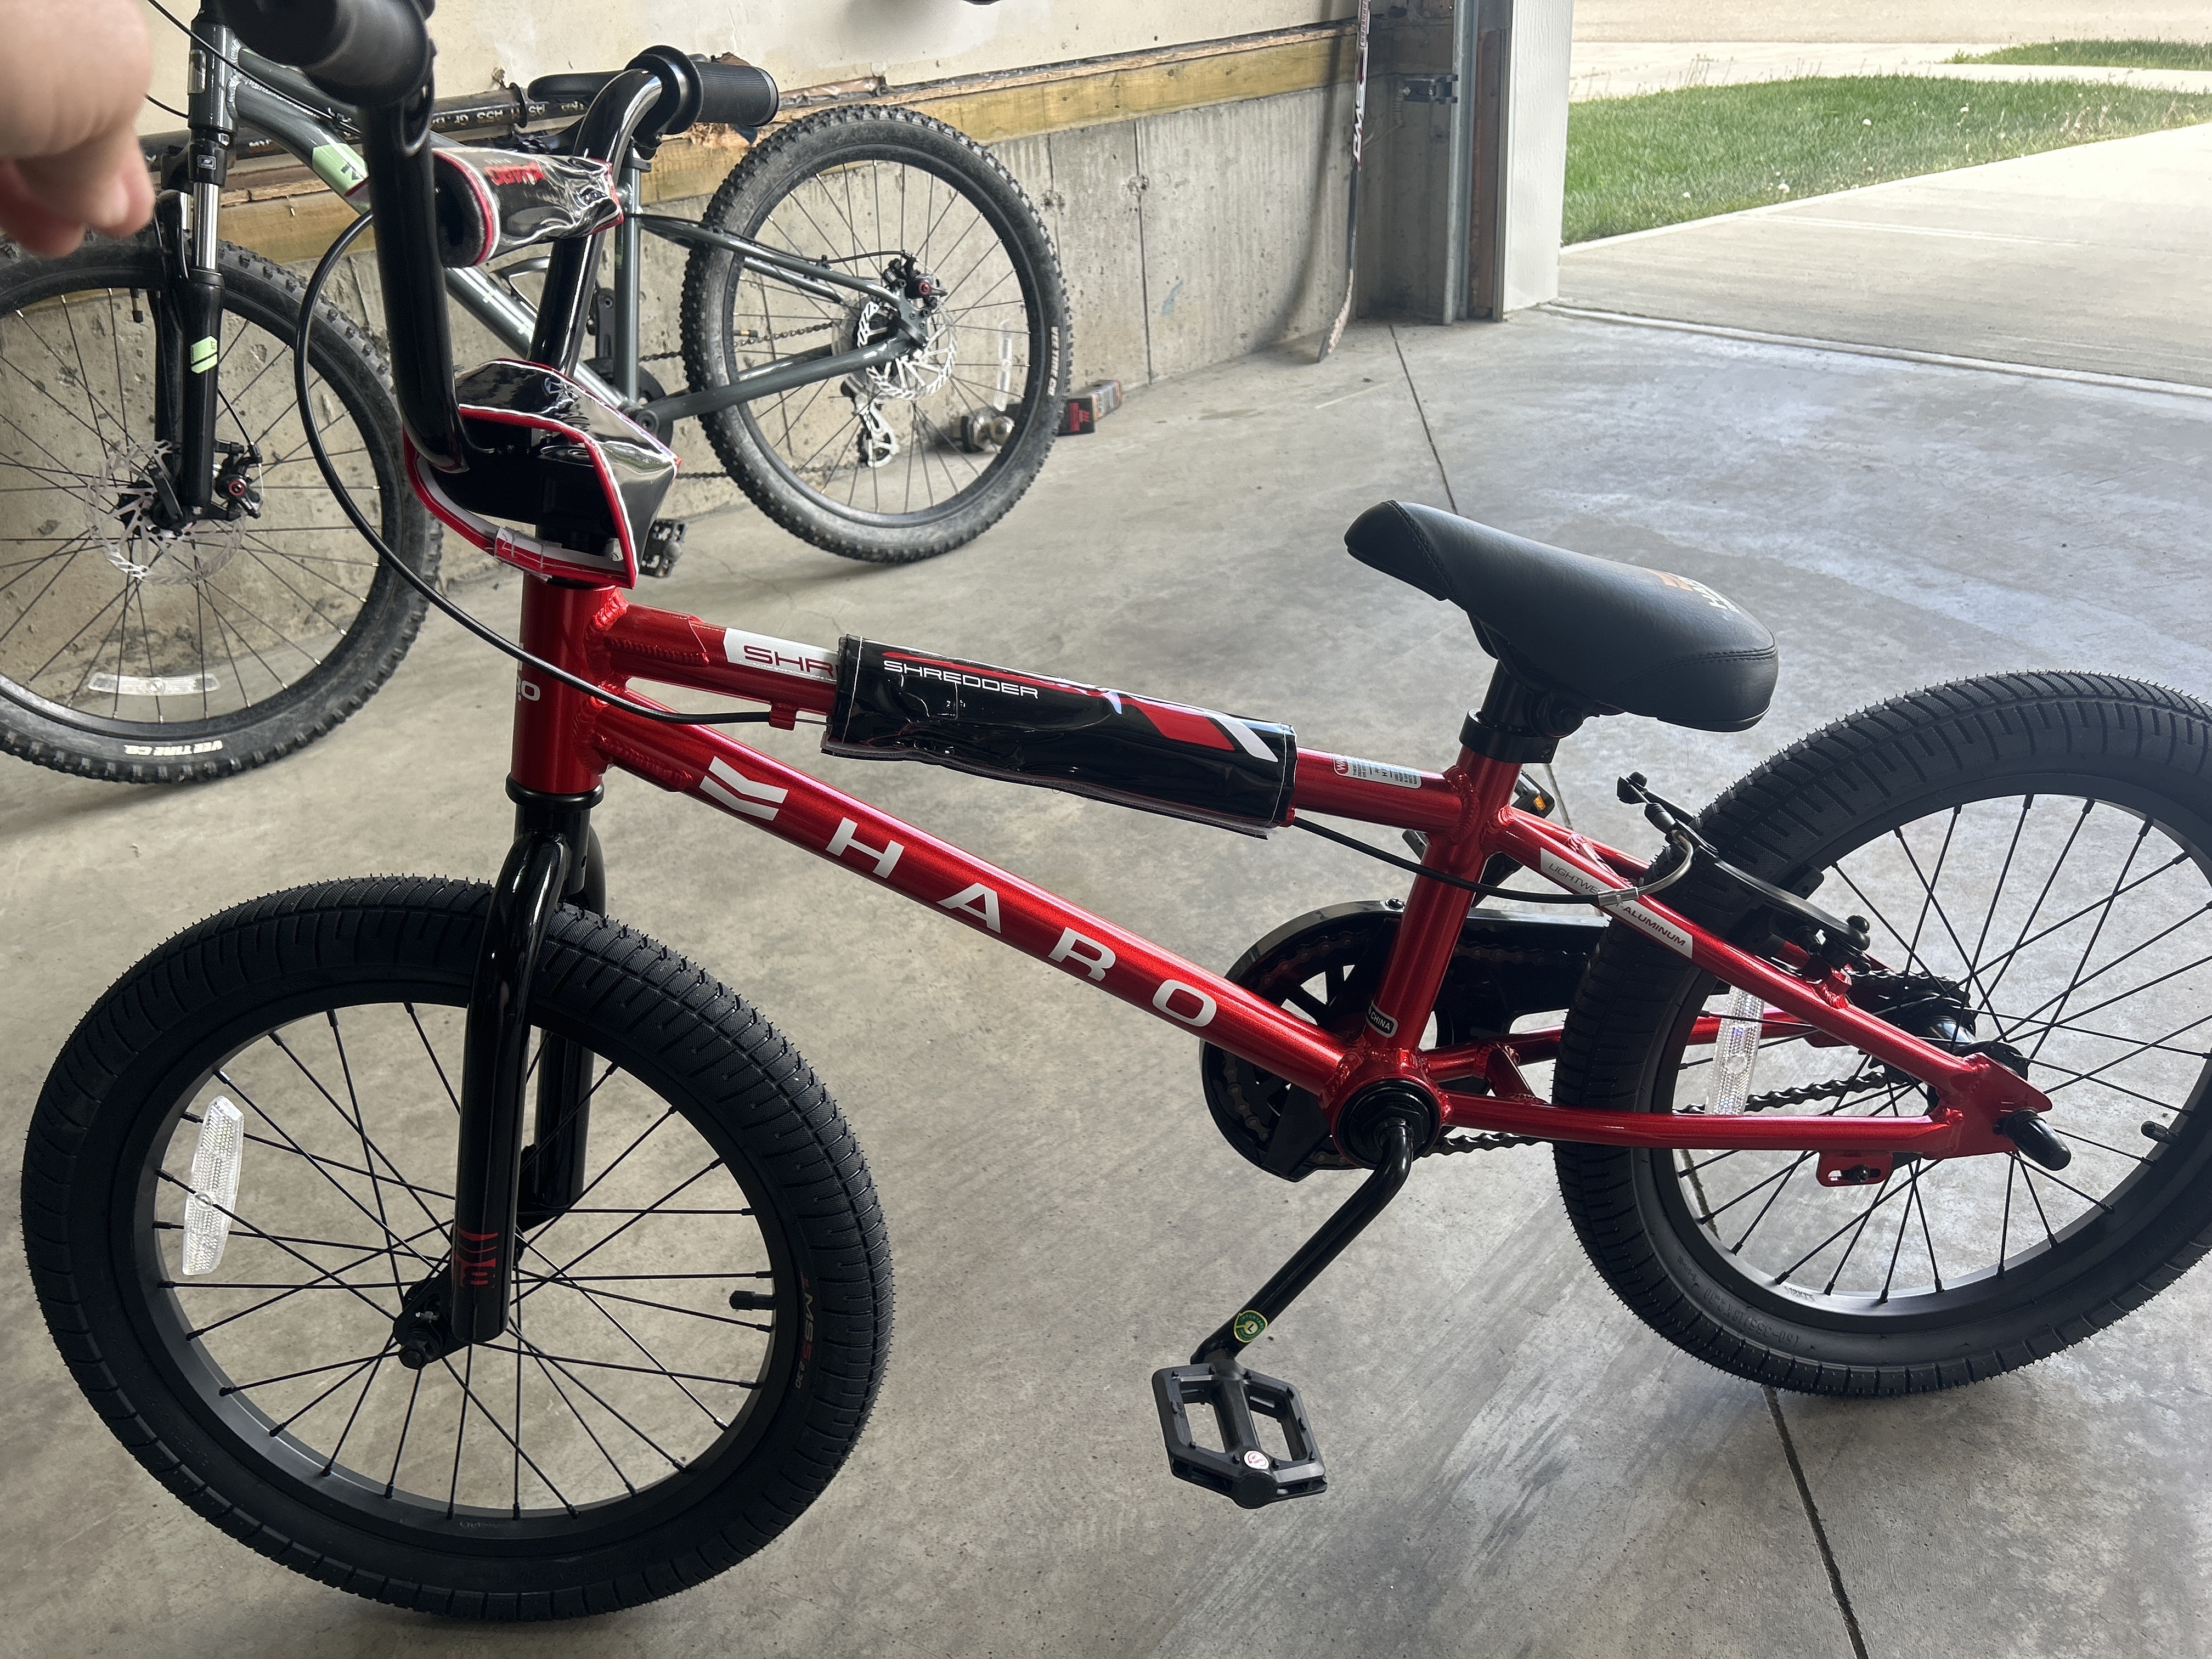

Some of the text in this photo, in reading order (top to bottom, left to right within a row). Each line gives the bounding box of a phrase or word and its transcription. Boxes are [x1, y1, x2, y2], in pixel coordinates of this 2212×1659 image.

[883, 660, 1039, 699] SHREDDER
[826, 817, 1217, 1028] HARO
[1370, 1012, 1392, 1031] CHINA
[1247, 1323, 1254, 1333] L
